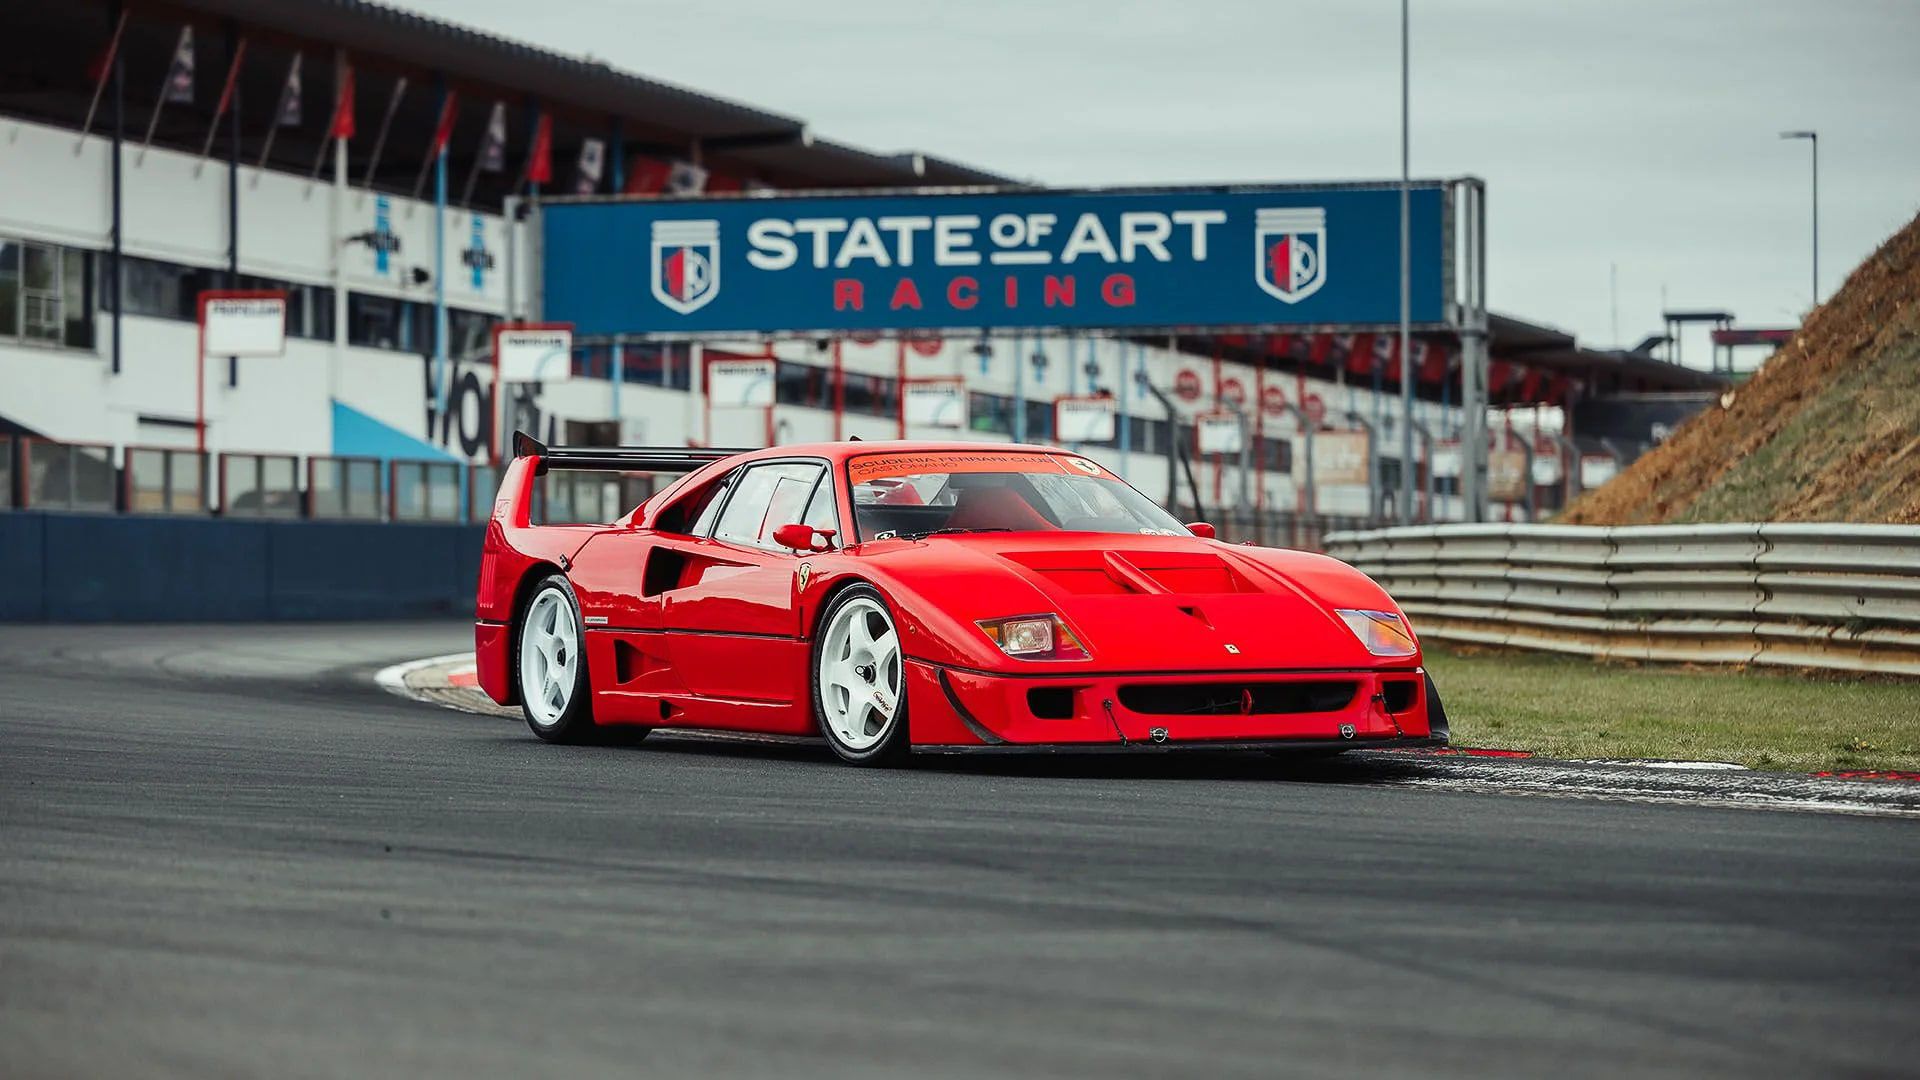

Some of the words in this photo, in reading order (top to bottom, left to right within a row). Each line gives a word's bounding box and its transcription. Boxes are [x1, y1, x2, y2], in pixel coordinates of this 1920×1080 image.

[747, 215, 982, 270] STATE
[989, 213, 1057, 248] OF
[1061, 210, 1227, 264] ART
[833, 274, 1136, 311] RACING
[851, 457, 936, 469] SCUDERIA
